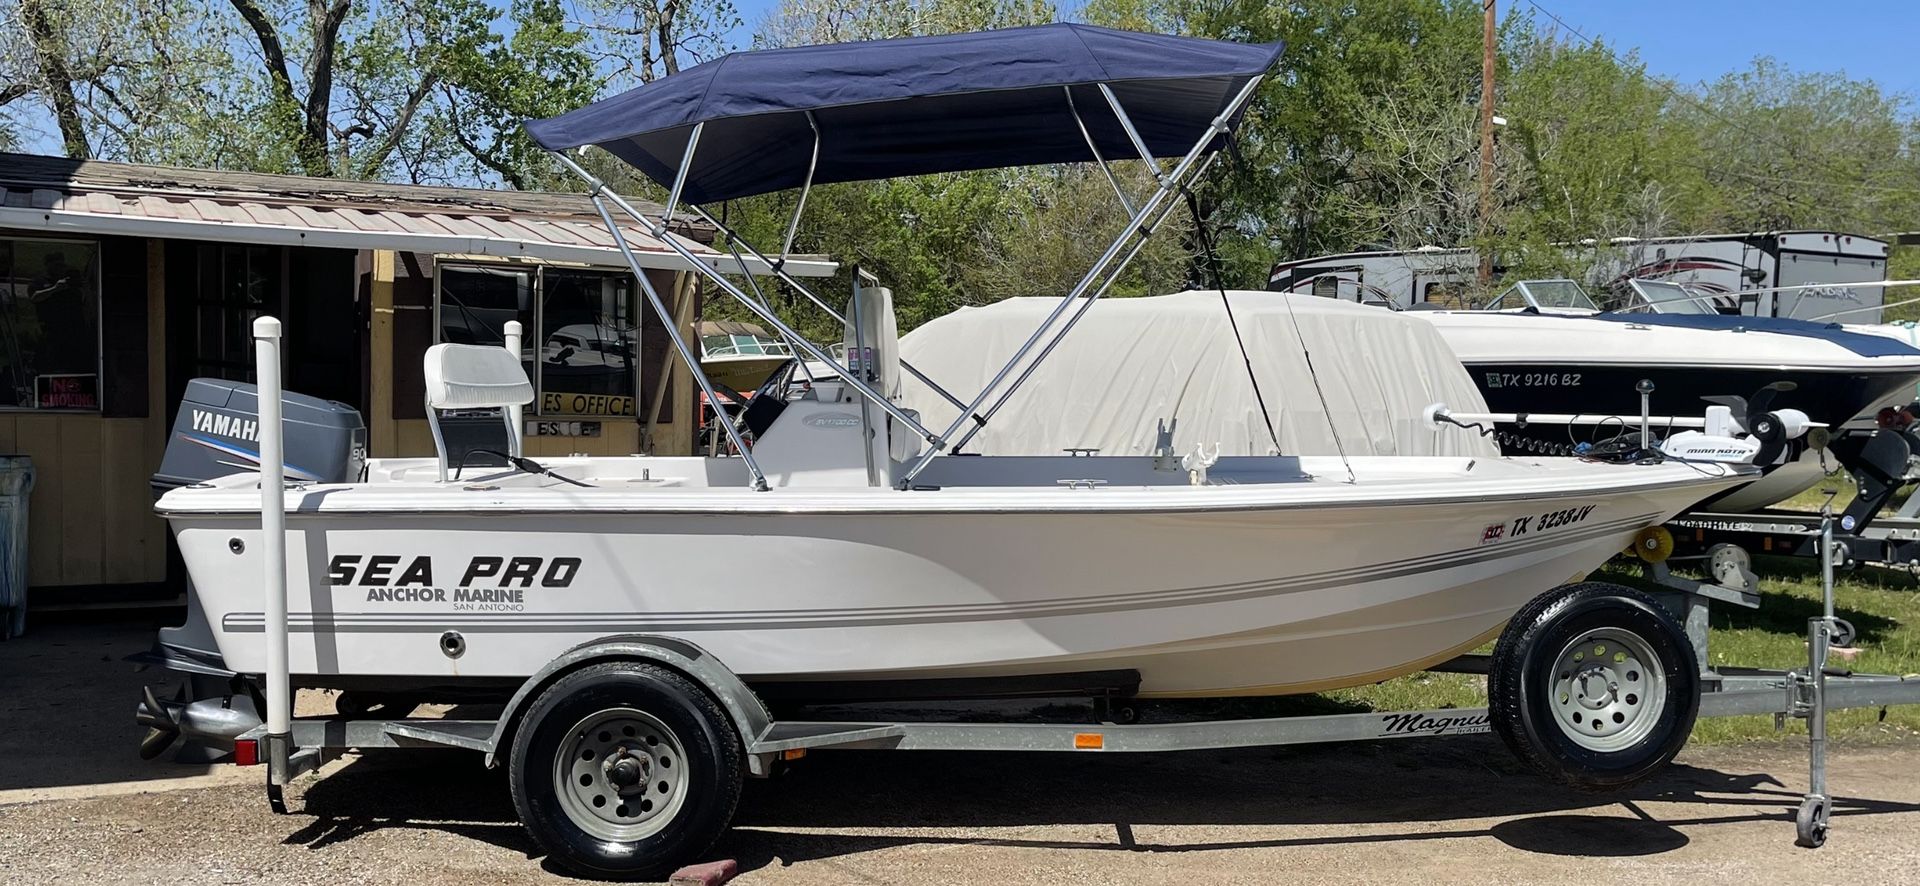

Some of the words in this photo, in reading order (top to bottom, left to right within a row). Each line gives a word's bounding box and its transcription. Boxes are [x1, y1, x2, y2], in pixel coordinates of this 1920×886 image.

[1502, 374, 1520, 387] TX
[1524, 373, 1558, 386] 9216
[1561, 373, 1582, 386] BZ
[41, 393, 95, 408] SMOKING
[572, 395, 632, 416] OFFICE
[192, 409, 261, 442] YAMAH
[1510, 516, 1534, 537] TX
[1536, 504, 1597, 532] 3238JV
[320, 555, 433, 587] SEA
[458, 556, 582, 588] PRO
[366, 588, 447, 602] ANCHOR
[453, 589, 524, 603] MARINE
[453, 602, 474, 612] SAN
[478, 603, 524, 612] ANTONIO
[1382, 713, 1490, 734] Magnu
